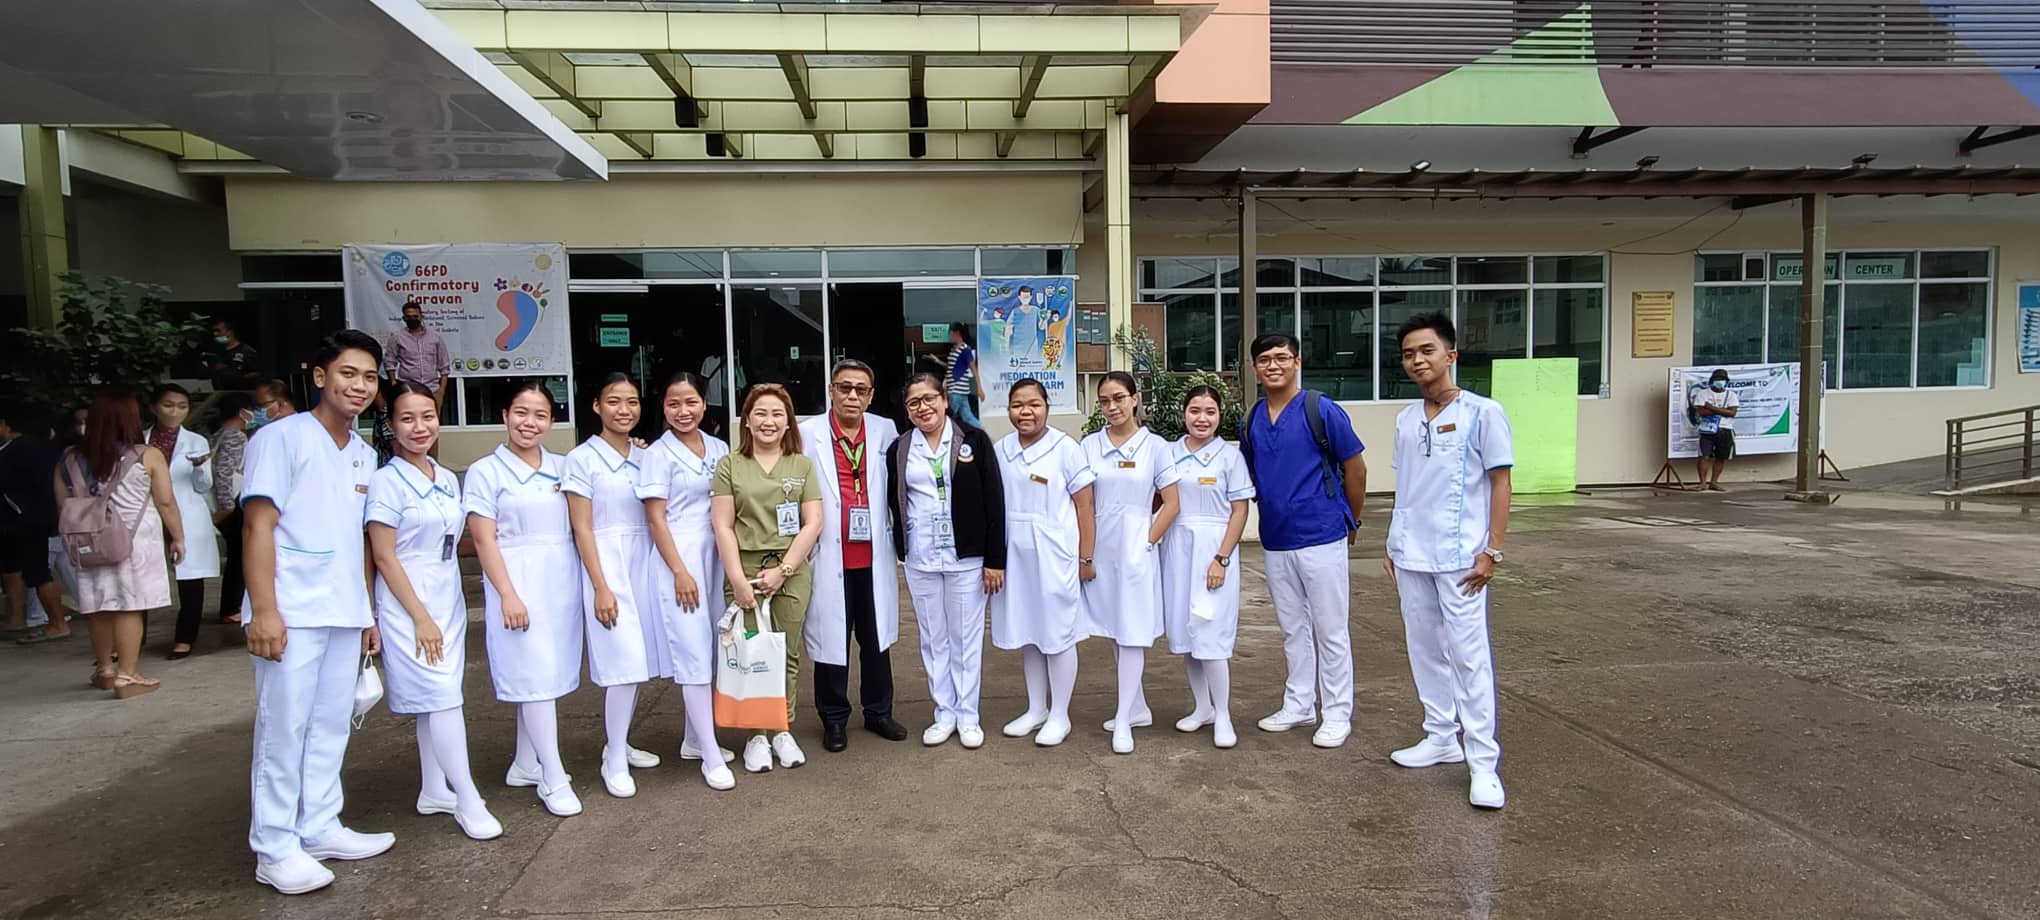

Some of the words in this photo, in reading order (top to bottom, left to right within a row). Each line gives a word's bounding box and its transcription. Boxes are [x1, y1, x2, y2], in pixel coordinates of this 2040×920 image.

[415, 265, 447, 277] G6PD
[1779, 265, 1834, 275] OPERN
[1855, 264, 1894, 274] CENTER
[385, 279, 479, 293] Confirmatory
[407, 293, 462, 305] Caravan
[1000, 371, 1056, 380] MEDICATION
